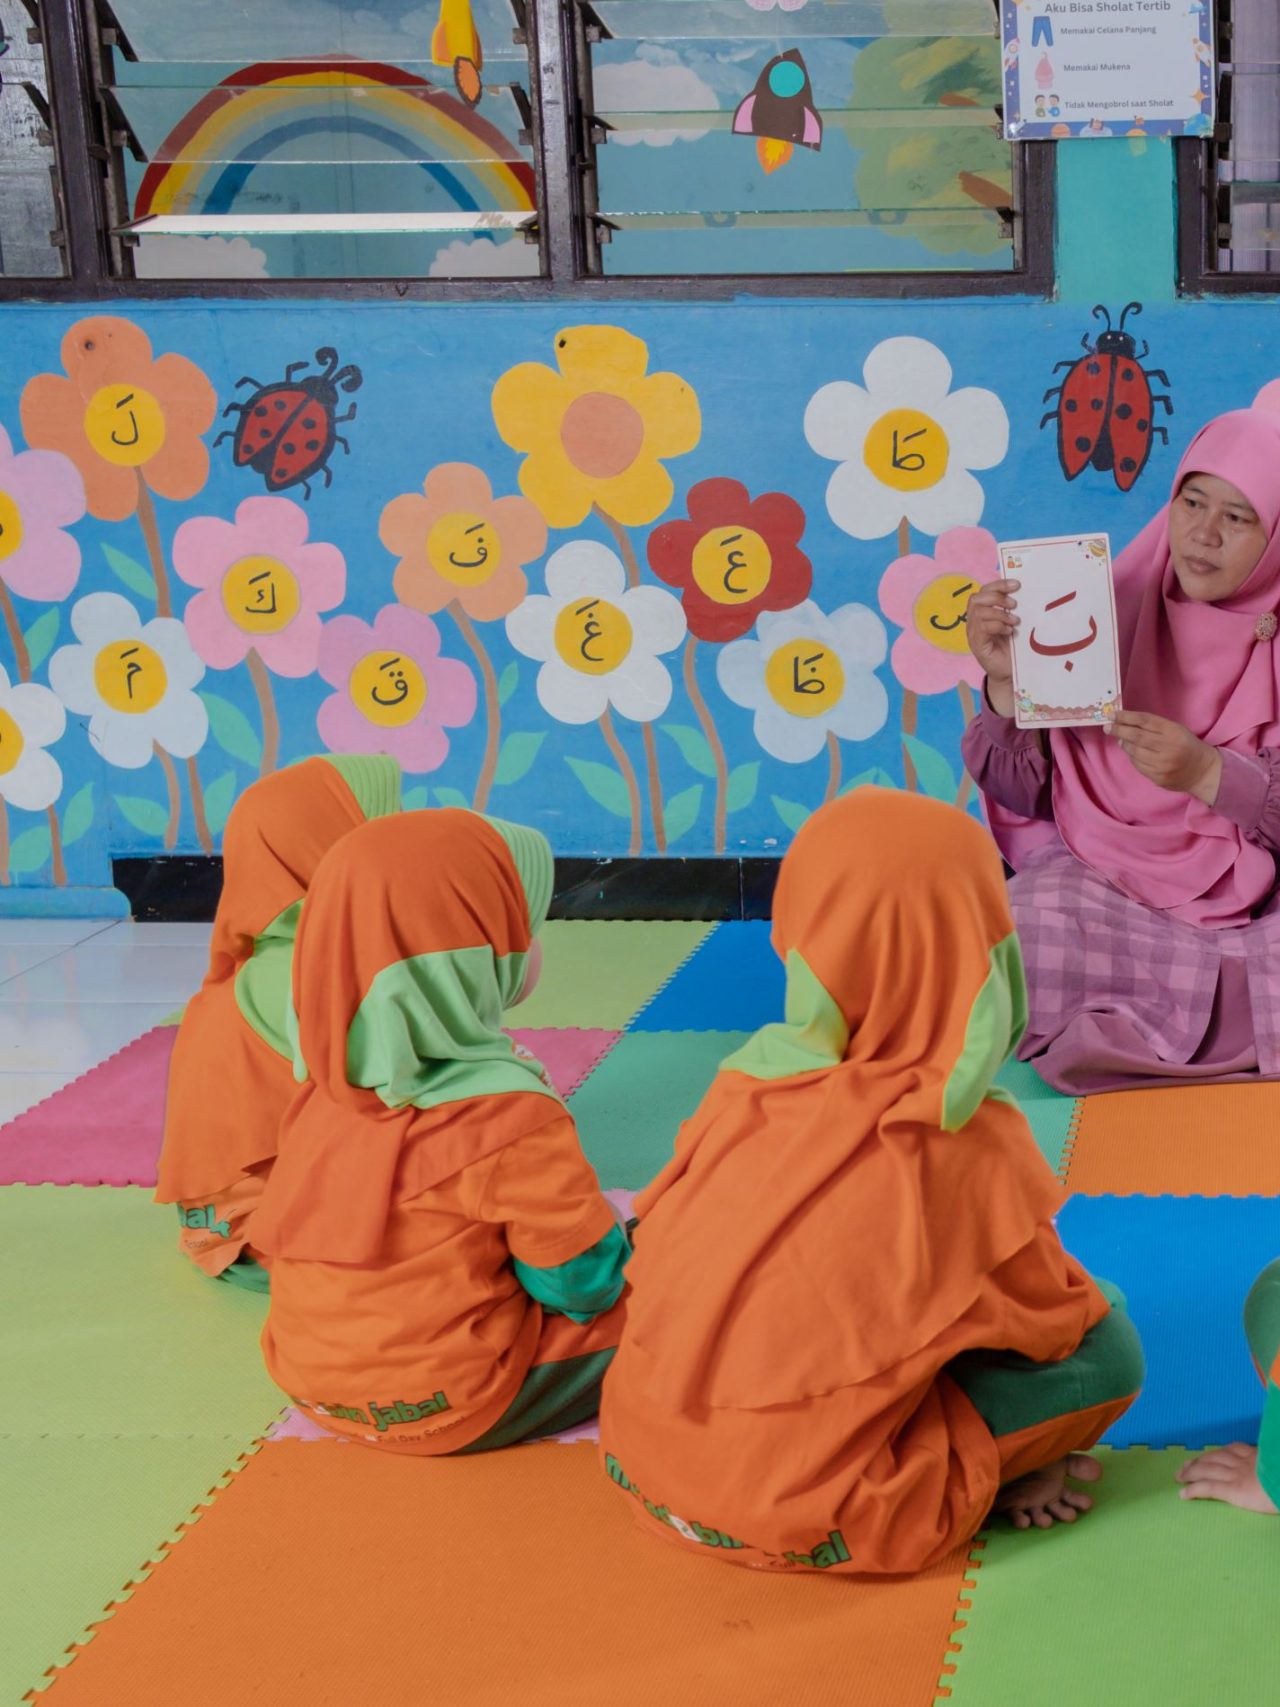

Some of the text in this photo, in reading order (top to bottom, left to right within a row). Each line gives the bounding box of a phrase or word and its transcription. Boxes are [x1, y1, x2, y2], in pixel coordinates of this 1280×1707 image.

[1044, 1, 1171, 14] Aku Bisa Sholat Tertib
[1097, 26, 1123, 34] Celana
[1125, 25, 1157, 35] Panjang
[1063, 63, 1131, 71] Memakai Mukena
[1064, 101, 1085, 109] Tidak
[1087, 100, 1129, 110] Mengobrol
[1149, 99, 1174, 107] Sholat
[367, 1390, 453, 1431] jabal
